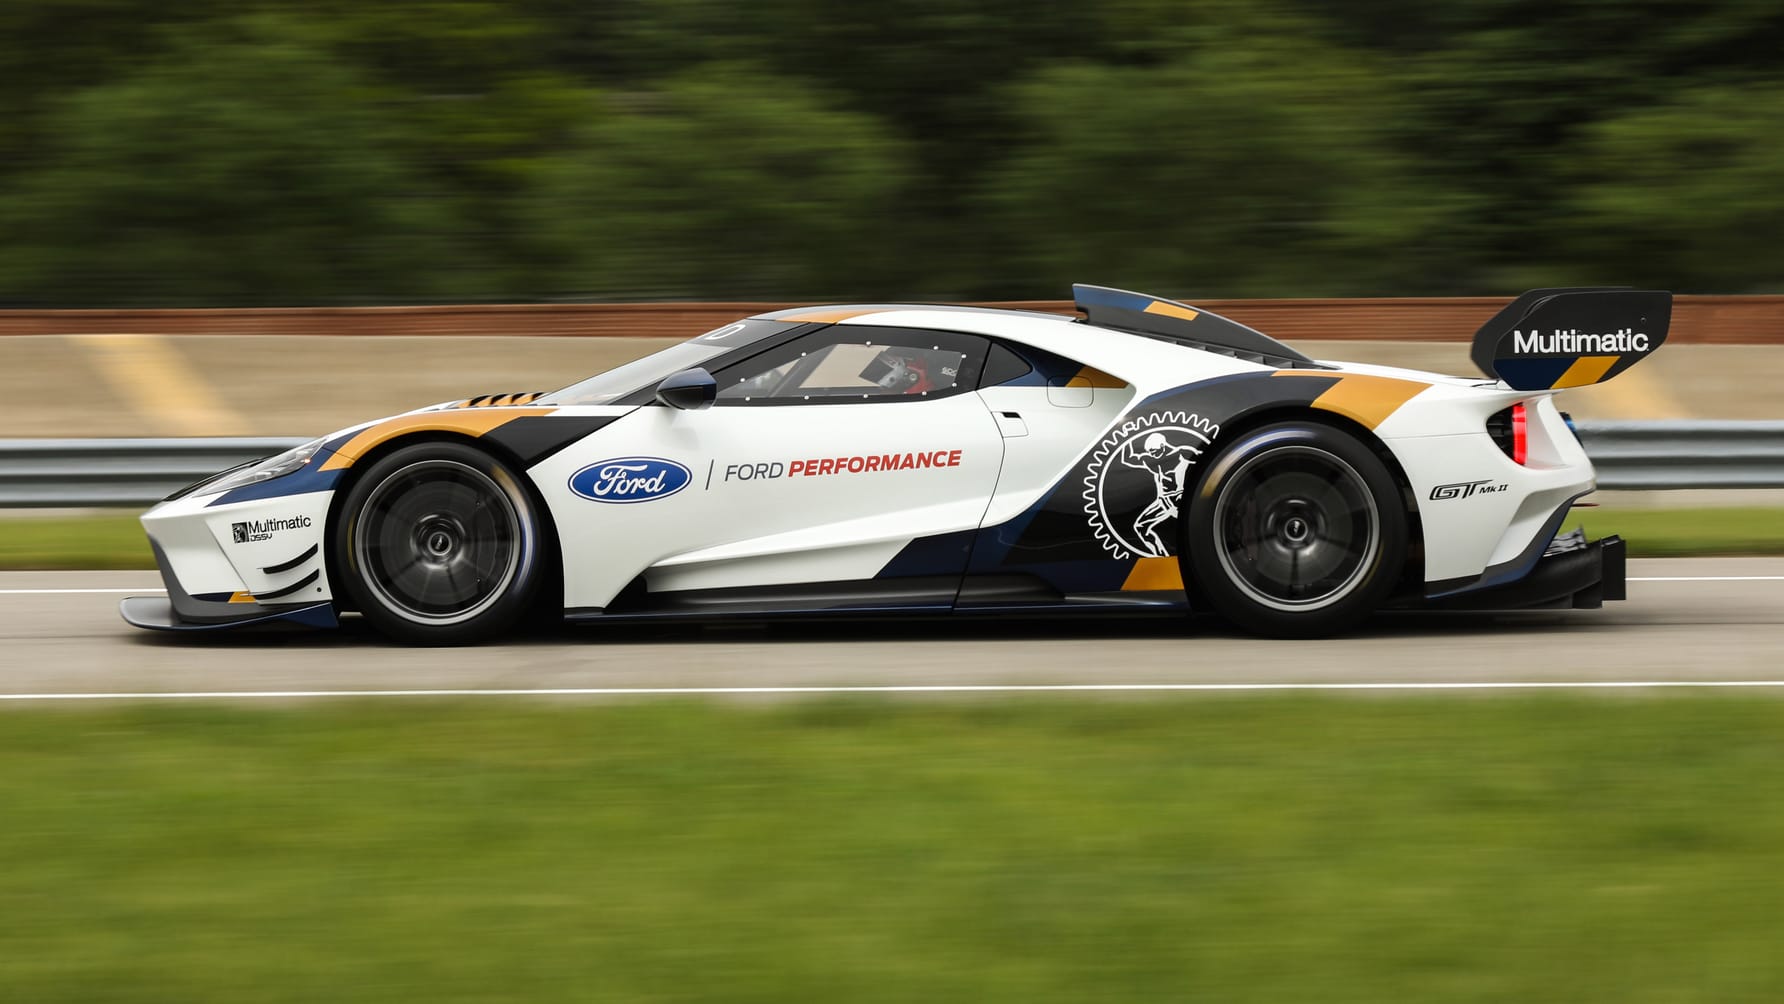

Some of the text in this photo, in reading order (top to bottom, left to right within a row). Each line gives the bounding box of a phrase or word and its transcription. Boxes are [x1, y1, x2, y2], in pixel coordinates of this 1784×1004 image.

[1513, 328, 1649, 354] Multimatic
[724, 450, 962, 482] FORD PERFORMANCE
[593, 463, 667, 497] Ford
[1429, 479, 1493, 500] GT
[1498, 484, 1508, 492] II
[248, 515, 311, 534] Multimatic
